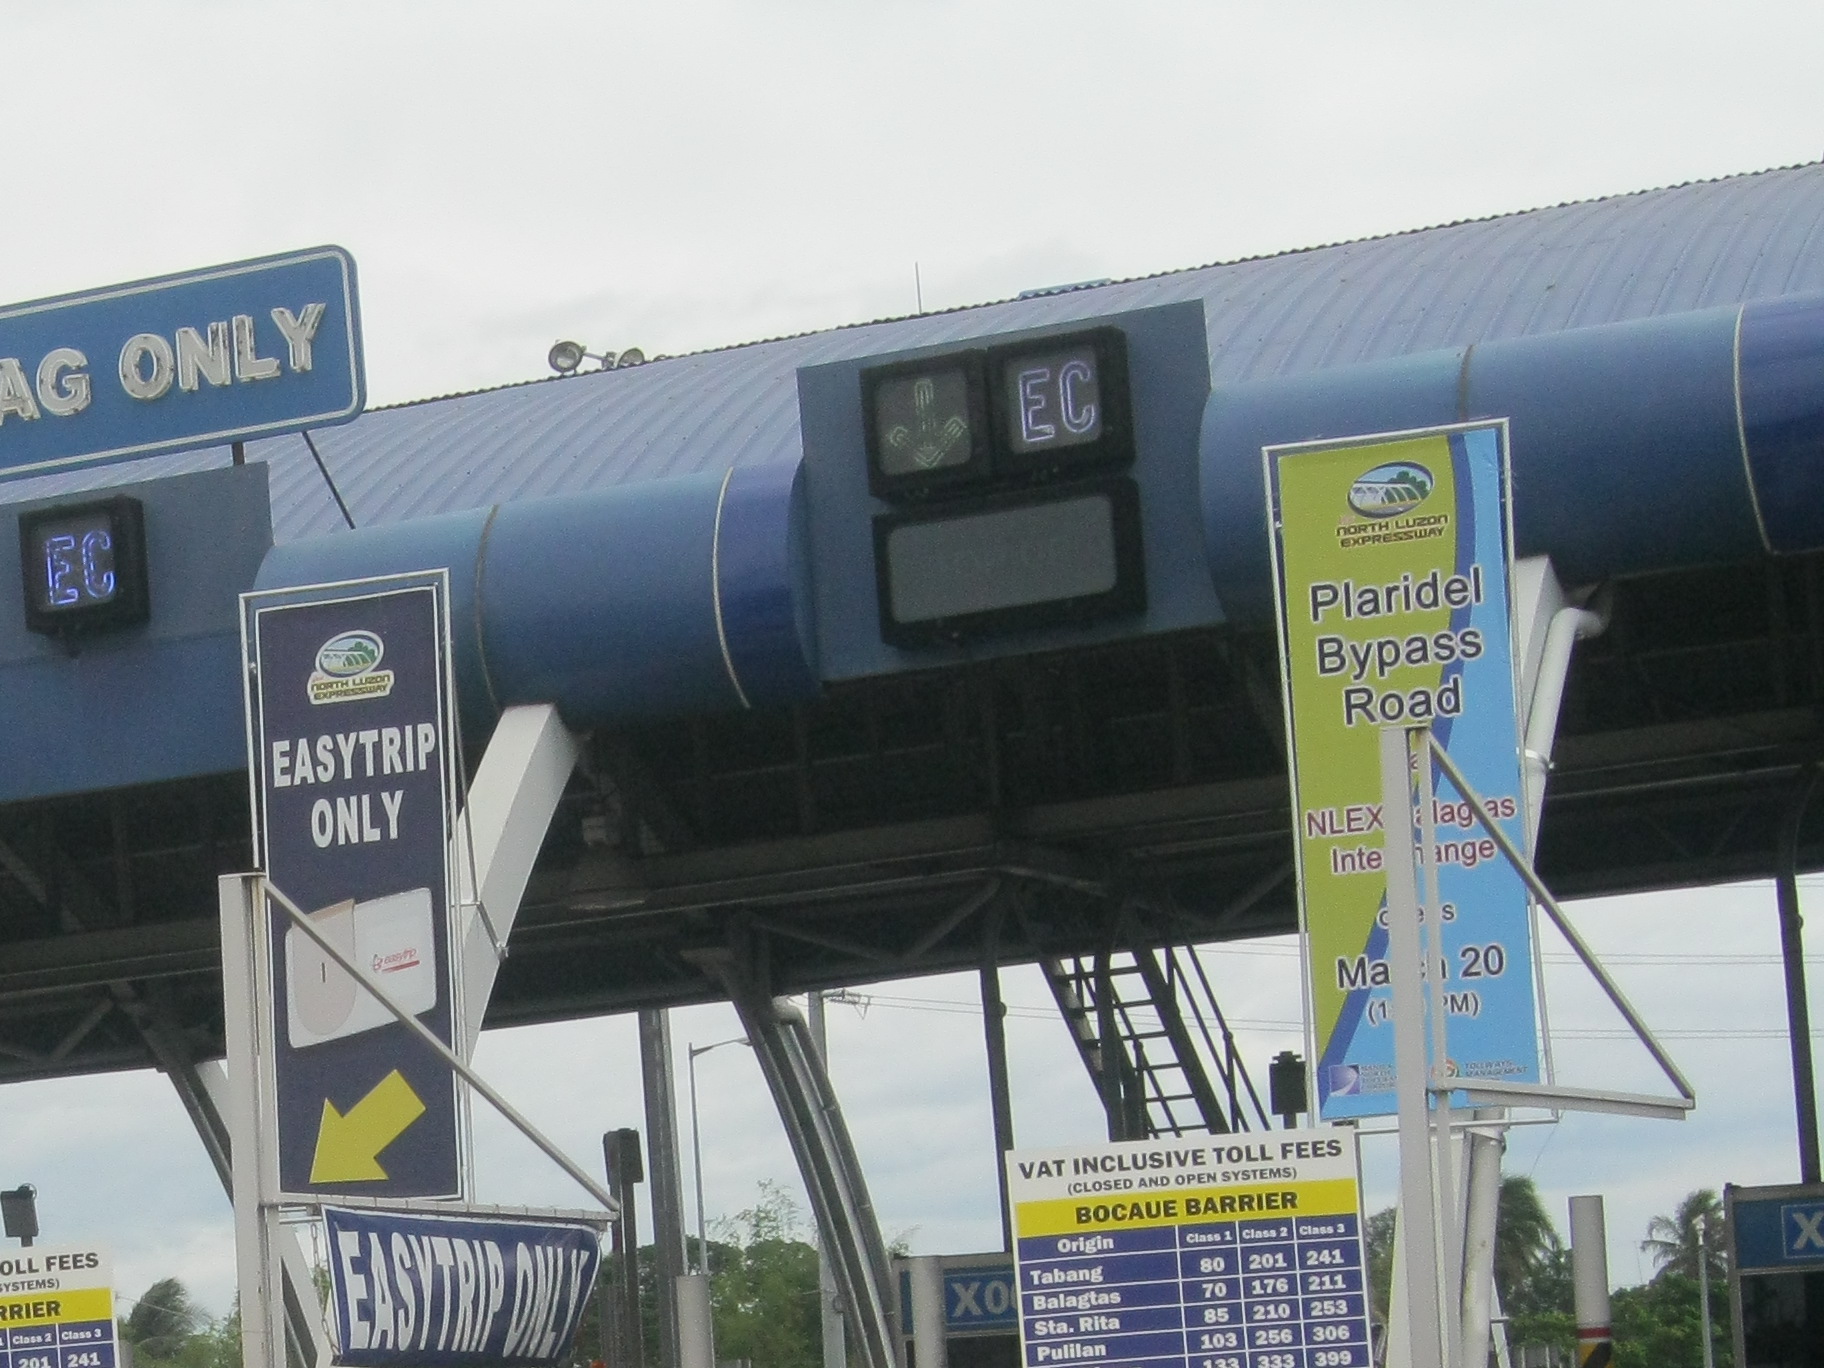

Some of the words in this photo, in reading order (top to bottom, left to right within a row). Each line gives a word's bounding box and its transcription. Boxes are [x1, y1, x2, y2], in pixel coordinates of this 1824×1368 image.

[118, 301, 328, 403] ONLY
[1018, 360, 1095, 442] EC
[1337, 521, 1389, 536] NORTH
[1395, 514, 1448, 529] LUZON
[1341, 527, 1445, 547] EXPRESSWAY
[45, 530, 116, 605] EC
[1310, 565, 1484, 623] Plaridel
[1317, 628, 1483, 681] Bypass
[1344, 676, 1462, 727] Road
[272, 723, 435, 787] EASYTRIP
[310, 790, 404, 847] ONLY
[1460, 945, 1504, 978] 20
[1020, 1158, 1065, 1180] VAT
[1073, 1148, 1206, 1174] INCLUSIVE
[1213, 1144, 1273, 1163] TOLL
[1281, 1139, 1342, 1159] FEES
[1068, 1178, 1133, 1195] (CLOSED
[1139, 1175, 1170, 1188] AND
[1176, 1172, 1217, 1185] OPEN
[1222, 1167, 1297, 1183] SYSTEMS)
[1077, 1199, 1178, 1224] BOCAUE
[1186, 1191, 1298, 1216] BARRIER
[1058, 1235, 1114, 1255] Origin
[1186, 1232, 1219, 1244] Class
[1224, 1230, 1232, 1240] 1
[1243, 1228, 1275, 1239] Class
[1279, 1226, 1288, 1236] 2
[1299, 1224, 1331, 1236] Class
[1335, 1223, 1345, 1233] 3
[46, 1252, 98, 1271] FEES
[1031, 1265, 1103, 1285] Tabang
[1200, 1257, 1225, 1273] 80
[1249, 1253, 1286, 1269] 201
[1307, 1249, 1344, 1265] 241
[338, 1230, 504, 1352] EASYTRIP
[503, 1242, 589, 1358] ONLY
[1033, 1289, 1121, 1311] Balagtas
[1202, 1283, 1227, 1298] 70
[1251, 1277, 1288, 1293] 176
[1308, 1274, 1345, 1290] 211
[1035, 1320, 1074, 1335] Sta.
[1079, 1316, 1120, 1332] Rita
[1204, 1308, 1229, 1323] 85
[1253, 1304, 1290, 1320] 210
[1311, 1300, 1348, 1316] 253
[12, 1334, 40, 1345] Class
[44, 1332, 52, 1342] 2
[62, 1329, 89, 1341] Class
[93, 1329, 102, 1338] 3
[1038, 1343, 1106, 1361] Pulilan
[1201, 1332, 1237, 1349] 103
[1255, 1329, 1292, 1345] 256
[1313, 1325, 1350, 1341] 306
[68, 1352, 100, 1368] 241
[1315, 1350, 1352, 1366] 399
